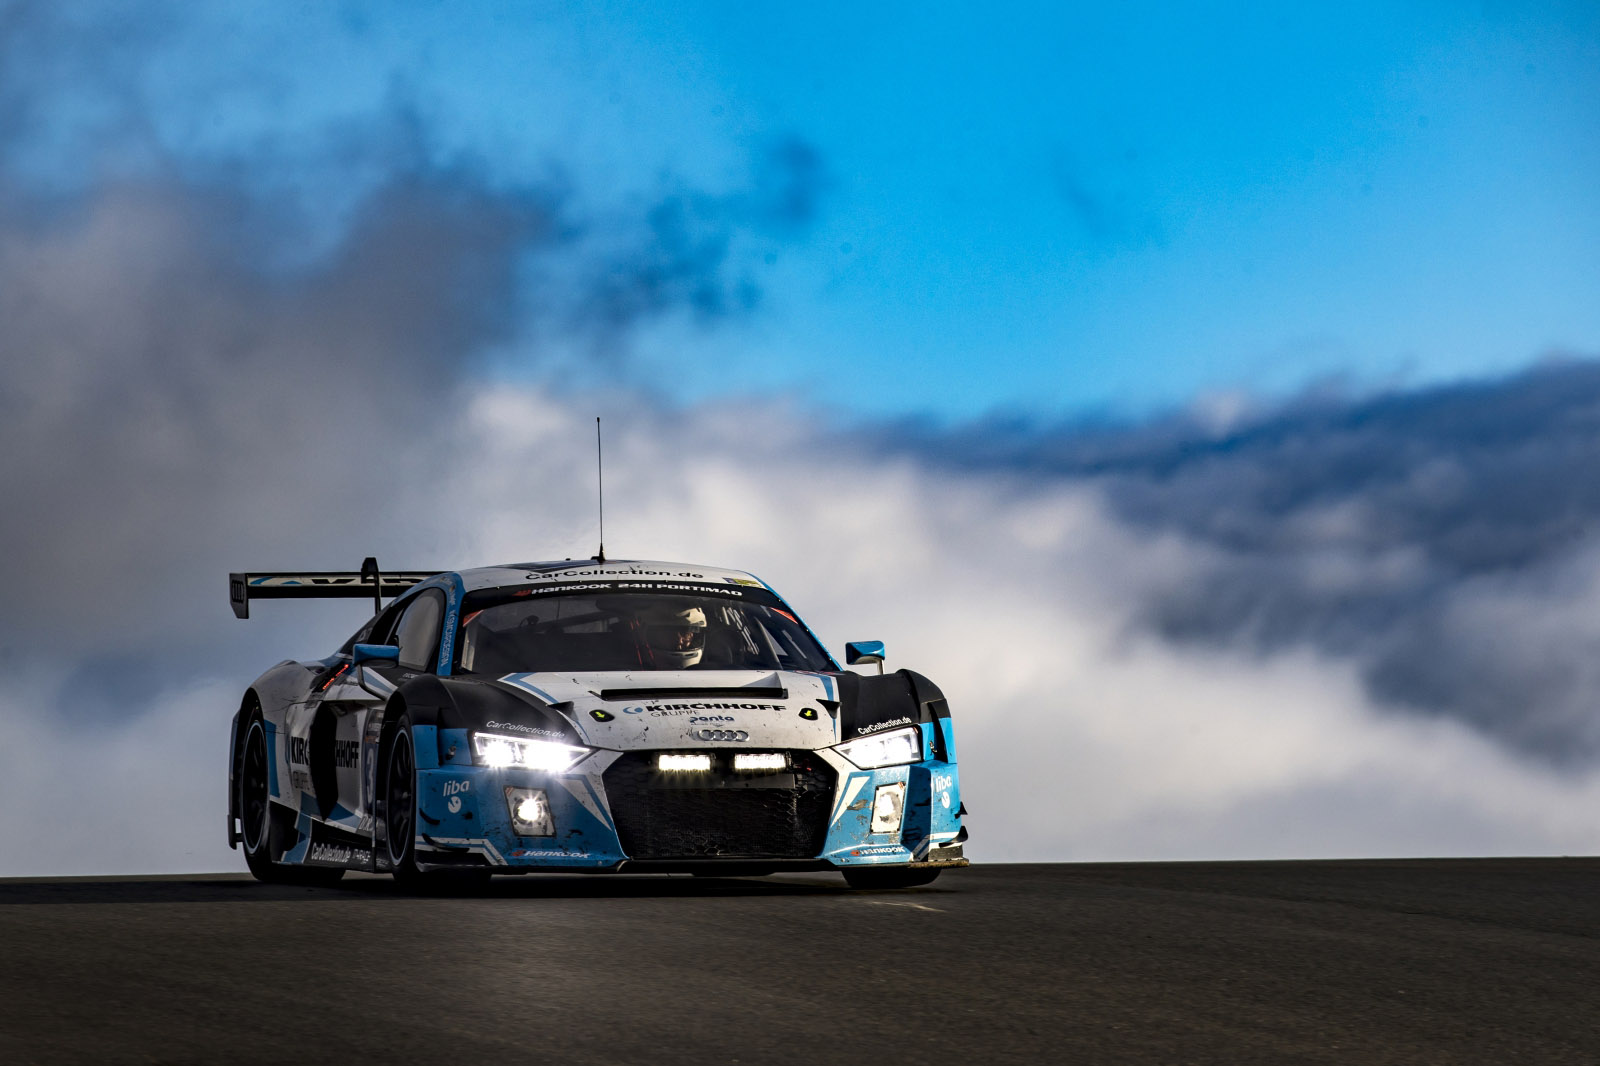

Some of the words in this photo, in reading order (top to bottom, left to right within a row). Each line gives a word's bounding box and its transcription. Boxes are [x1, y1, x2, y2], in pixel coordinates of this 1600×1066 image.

[525, 569, 704, 580] CarCollection.de
[645, 703, 787, 712] KIRCHHOFF
[486, 720, 565, 738] CarCollection.de
[857, 716, 912, 735] CarCollection.de
[443, 780, 470, 797] liba
[935, 775, 952, 793] liba
